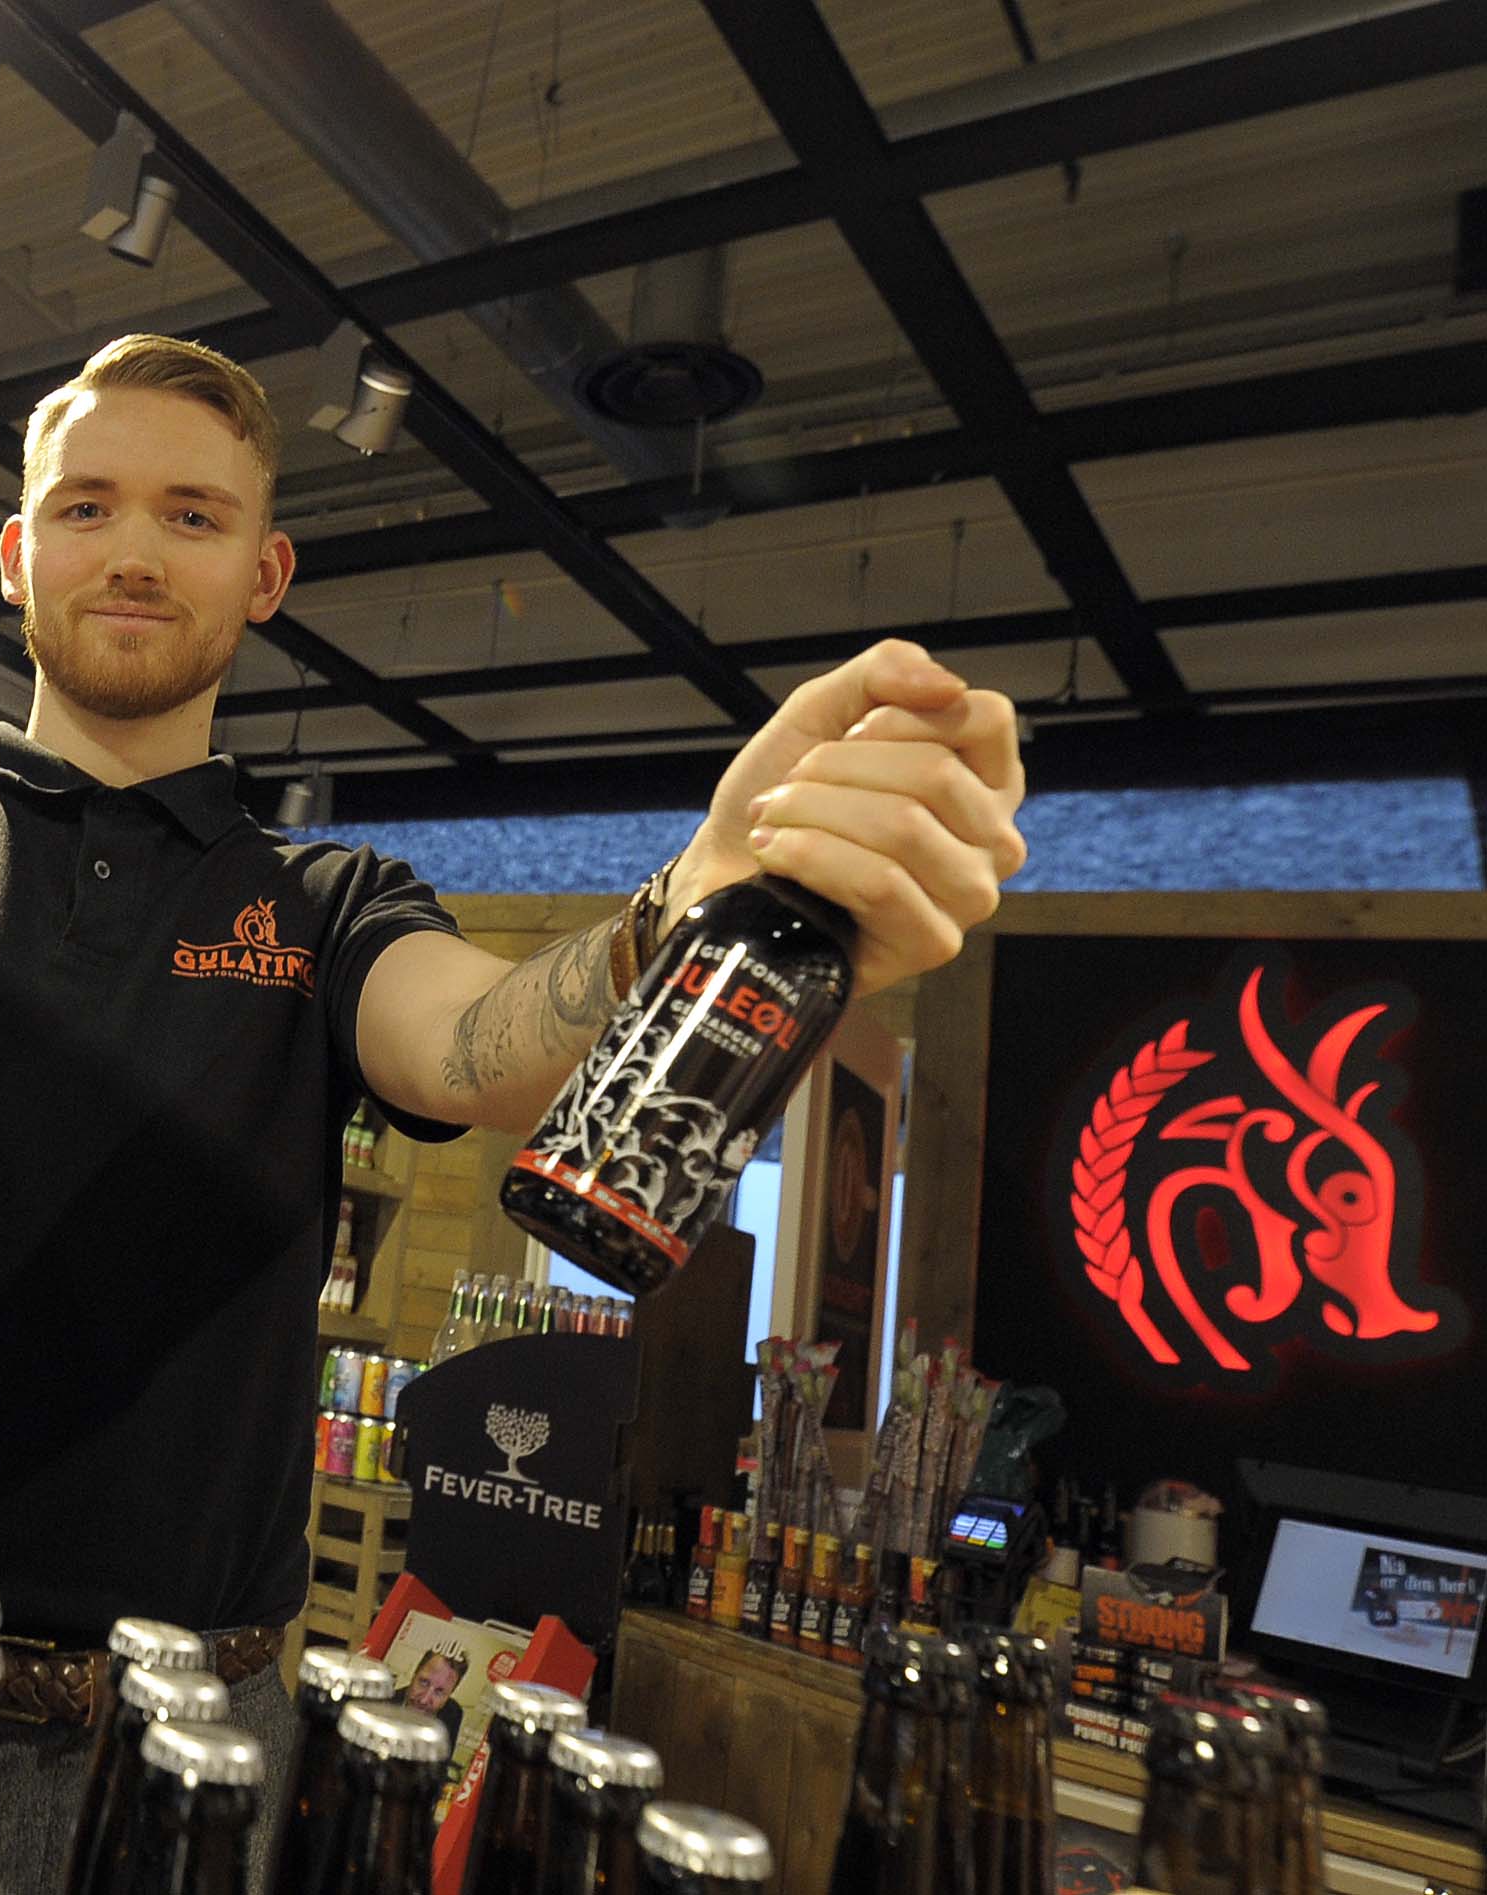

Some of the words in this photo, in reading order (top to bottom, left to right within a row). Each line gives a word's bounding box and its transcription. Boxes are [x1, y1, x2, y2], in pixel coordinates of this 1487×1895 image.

[174, 948, 315, 988] GULATING
[699, 943, 801, 1007] GEFONNA
[669, 998, 763, 1056] GEANGER
[424, 1465, 603, 1529] FEVER-TREE
[1096, 1592, 1207, 1645] STRONG
